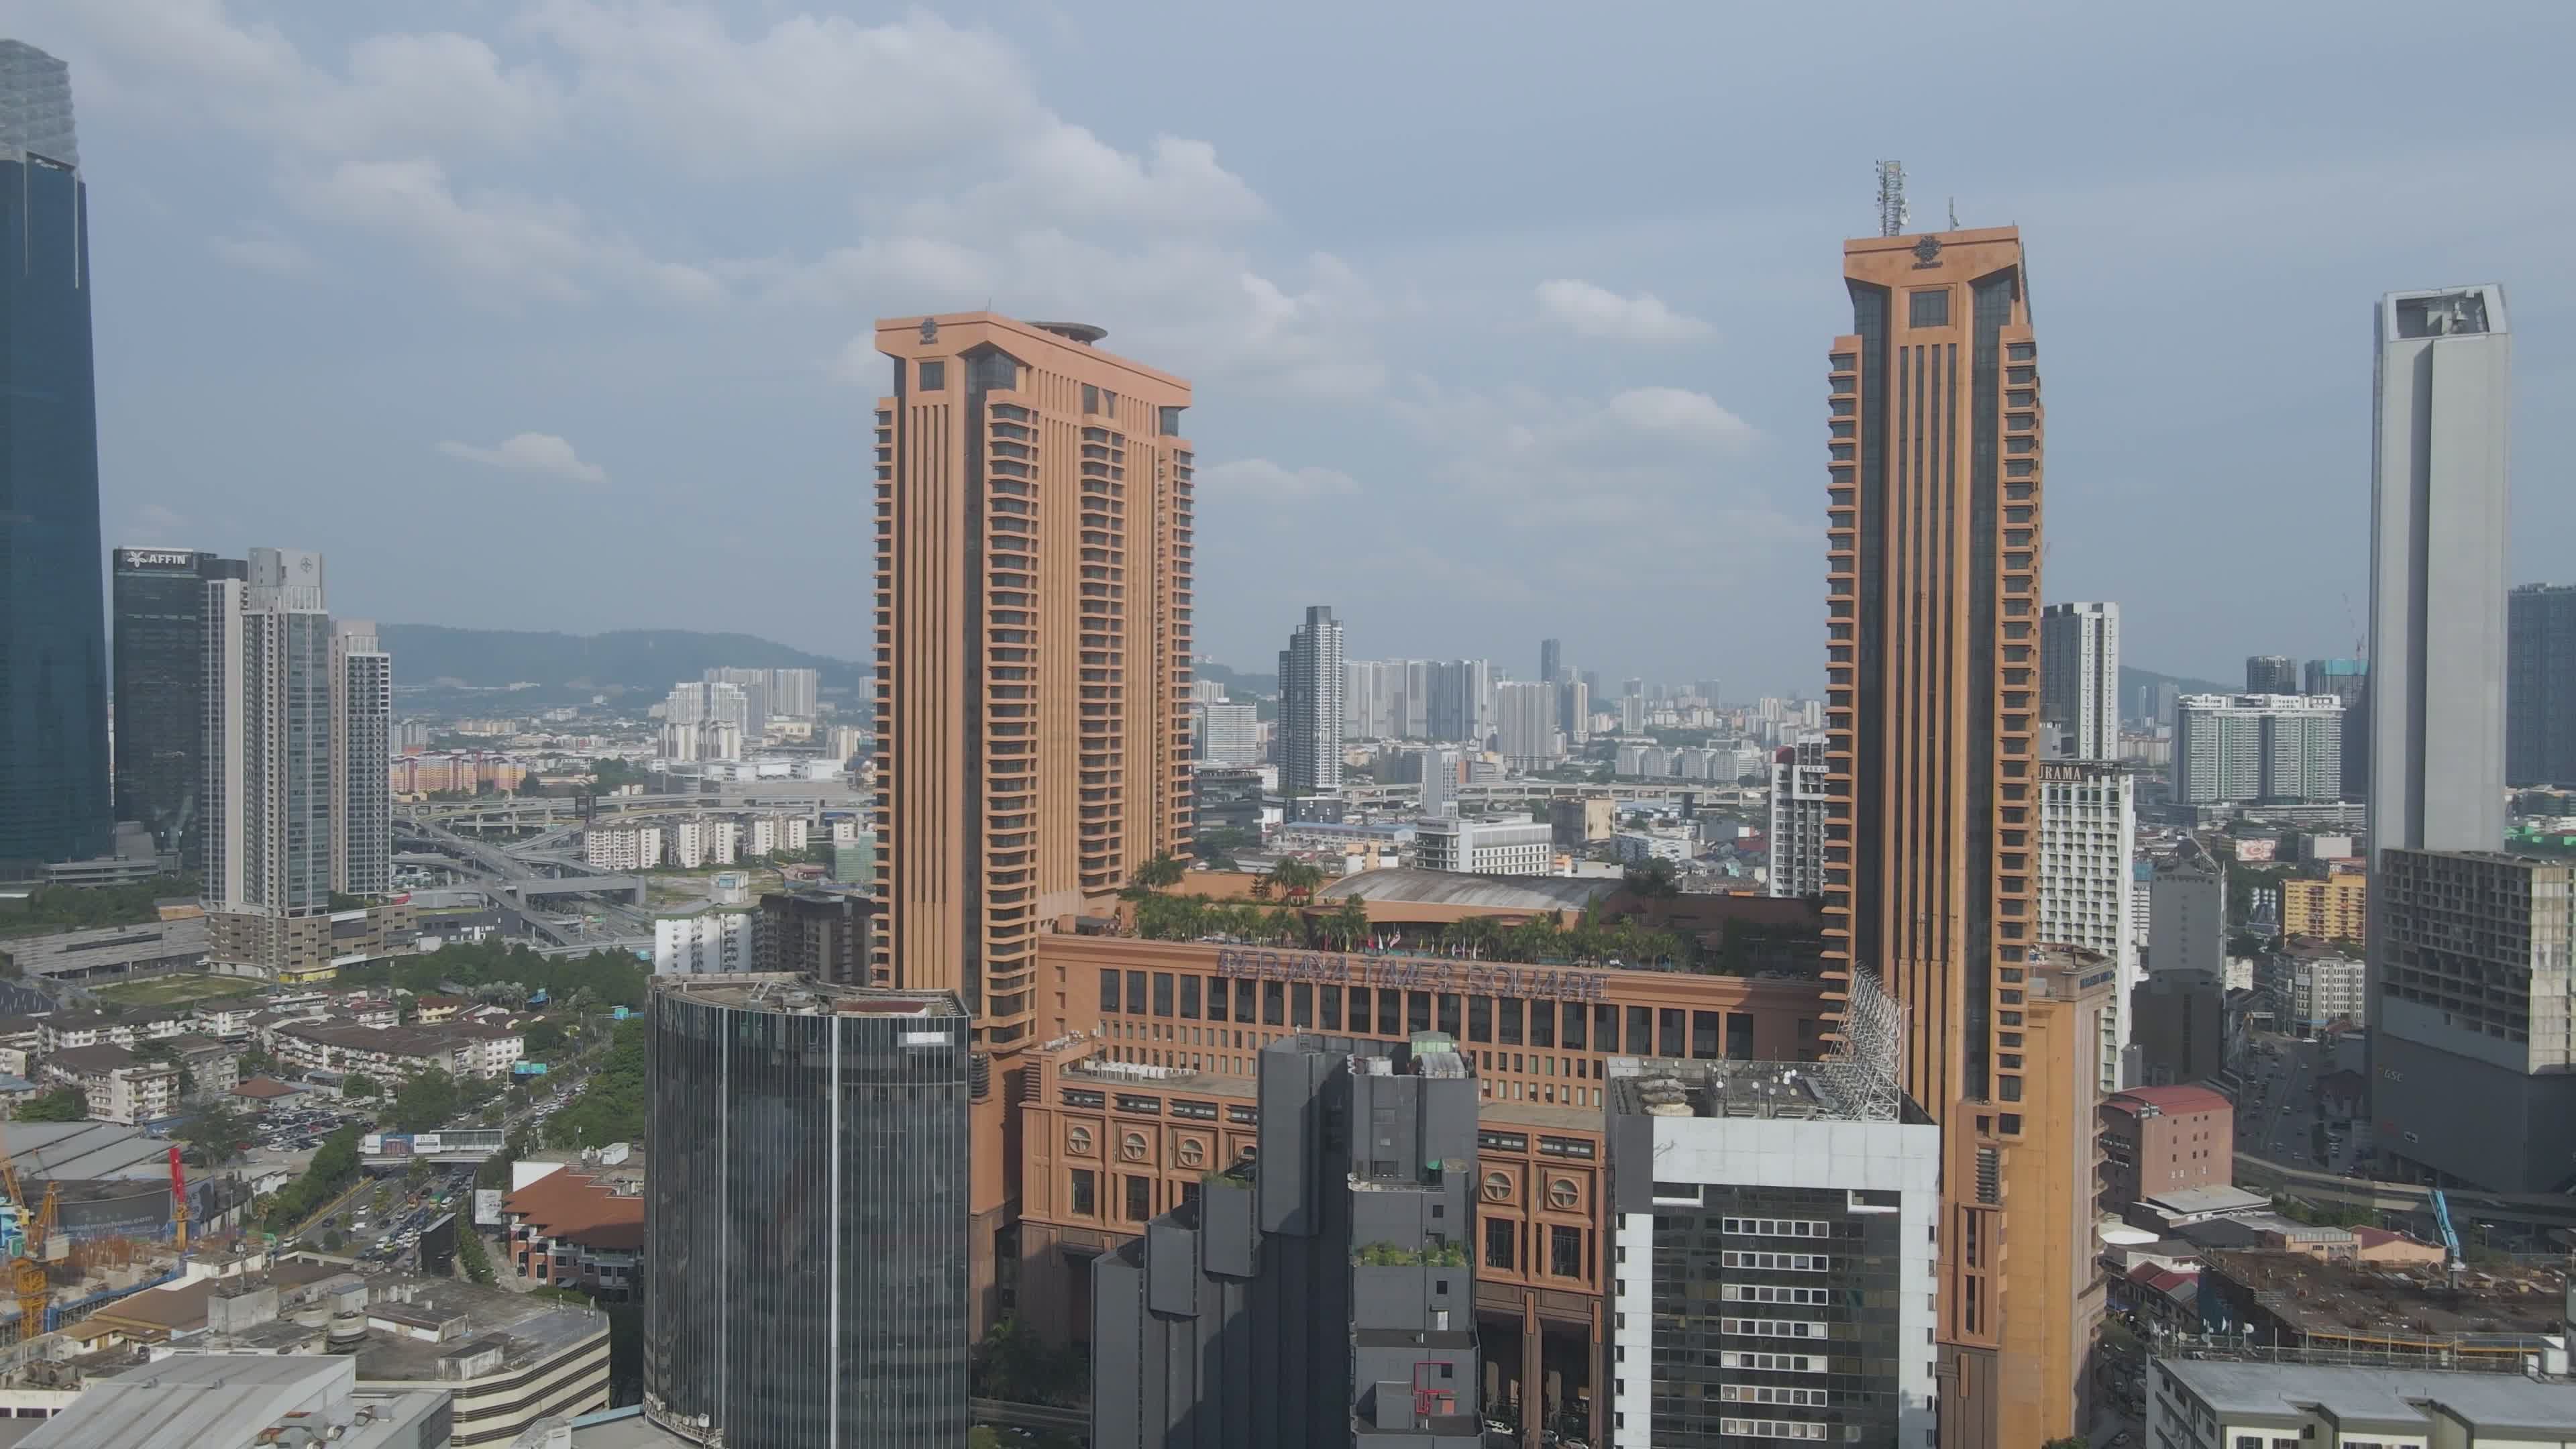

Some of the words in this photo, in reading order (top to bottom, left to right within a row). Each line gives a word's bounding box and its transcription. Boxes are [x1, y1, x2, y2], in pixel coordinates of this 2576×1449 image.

[148, 554, 186, 564] AFFIN
[1218, 949, 1352, 982] BERJAYA
[1358, 957, 1454, 991] TIMES
[1465, 965, 1609, 1000] SQUARE
